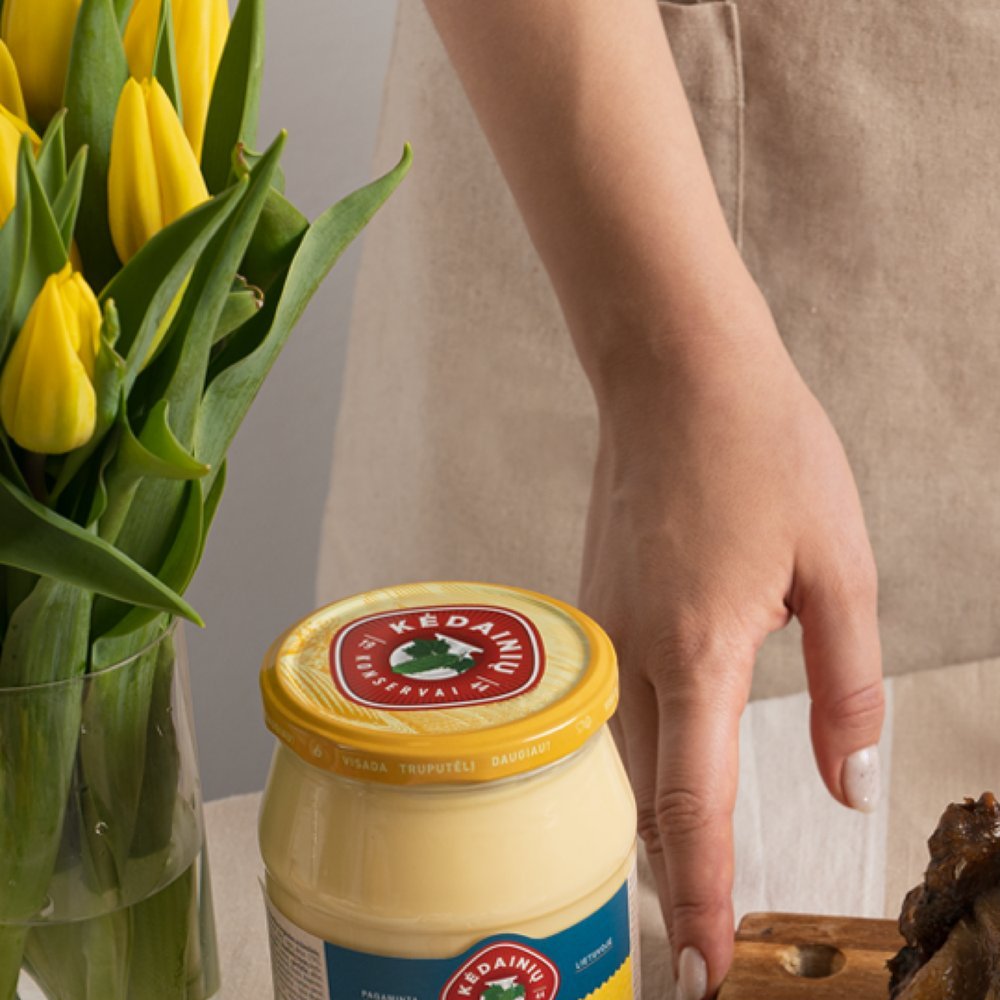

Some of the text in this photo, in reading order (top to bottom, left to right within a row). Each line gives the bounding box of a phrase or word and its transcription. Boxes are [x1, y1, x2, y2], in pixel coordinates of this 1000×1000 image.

[388, 612, 523, 674] KĖDAINIŲ
[342, 756, 388, 773] VISADA
[457, 955, 544, 996] KĖDAINIŲ
